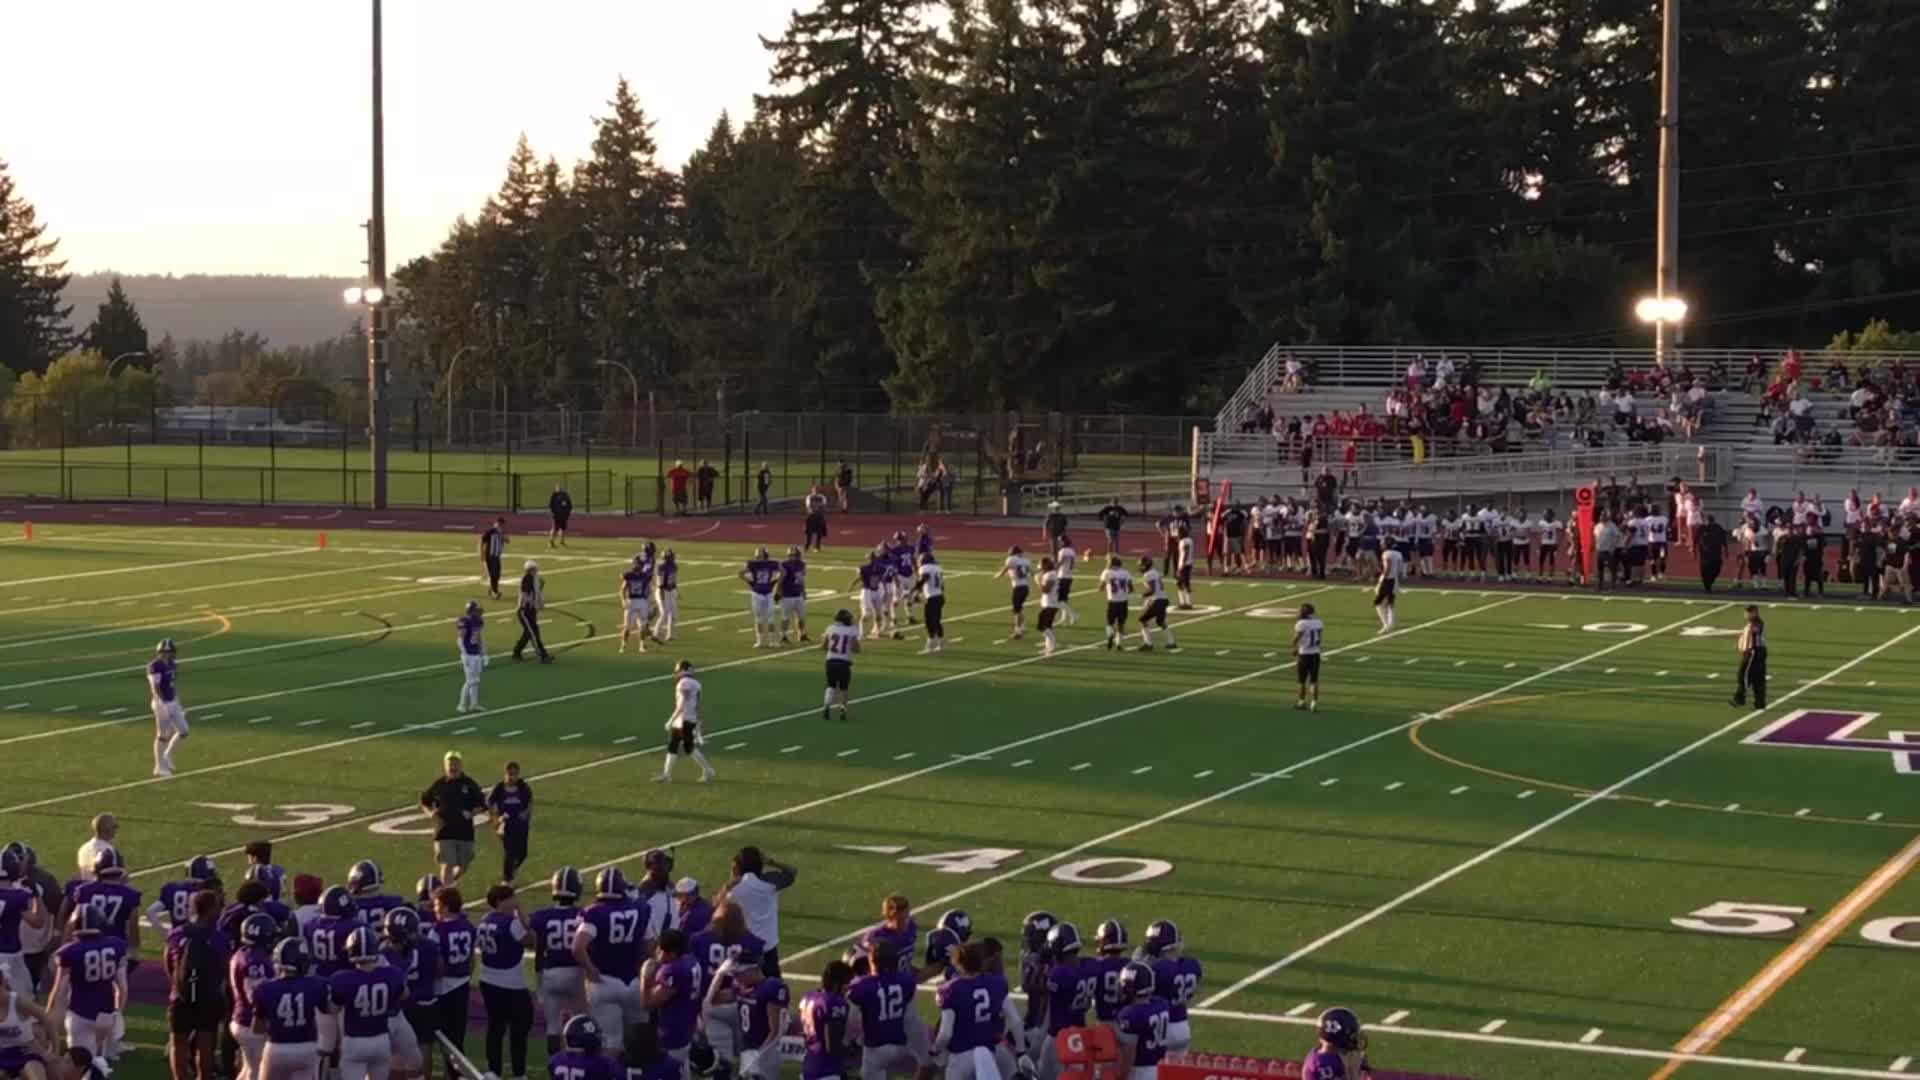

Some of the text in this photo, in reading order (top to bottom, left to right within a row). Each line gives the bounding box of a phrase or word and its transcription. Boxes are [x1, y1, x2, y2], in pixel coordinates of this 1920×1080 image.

[546, 919, 575, 950] 26
[608, 910, 639, 944] 67
[312, 929, 336, 961] 61
[447, 930, 472, 964] 53
[84, 946, 117, 982] 86
[353, 982, 389, 1018] 40
[876, 984, 904, 1022] 12
[972, 987, 992, 1023] 2
[1172, 973, 1198, 1006] 32
[275, 987, 307, 1028] 41
[1067, 1033, 1084, 1053] G
[1145, 1010, 1169, 1049] 30
